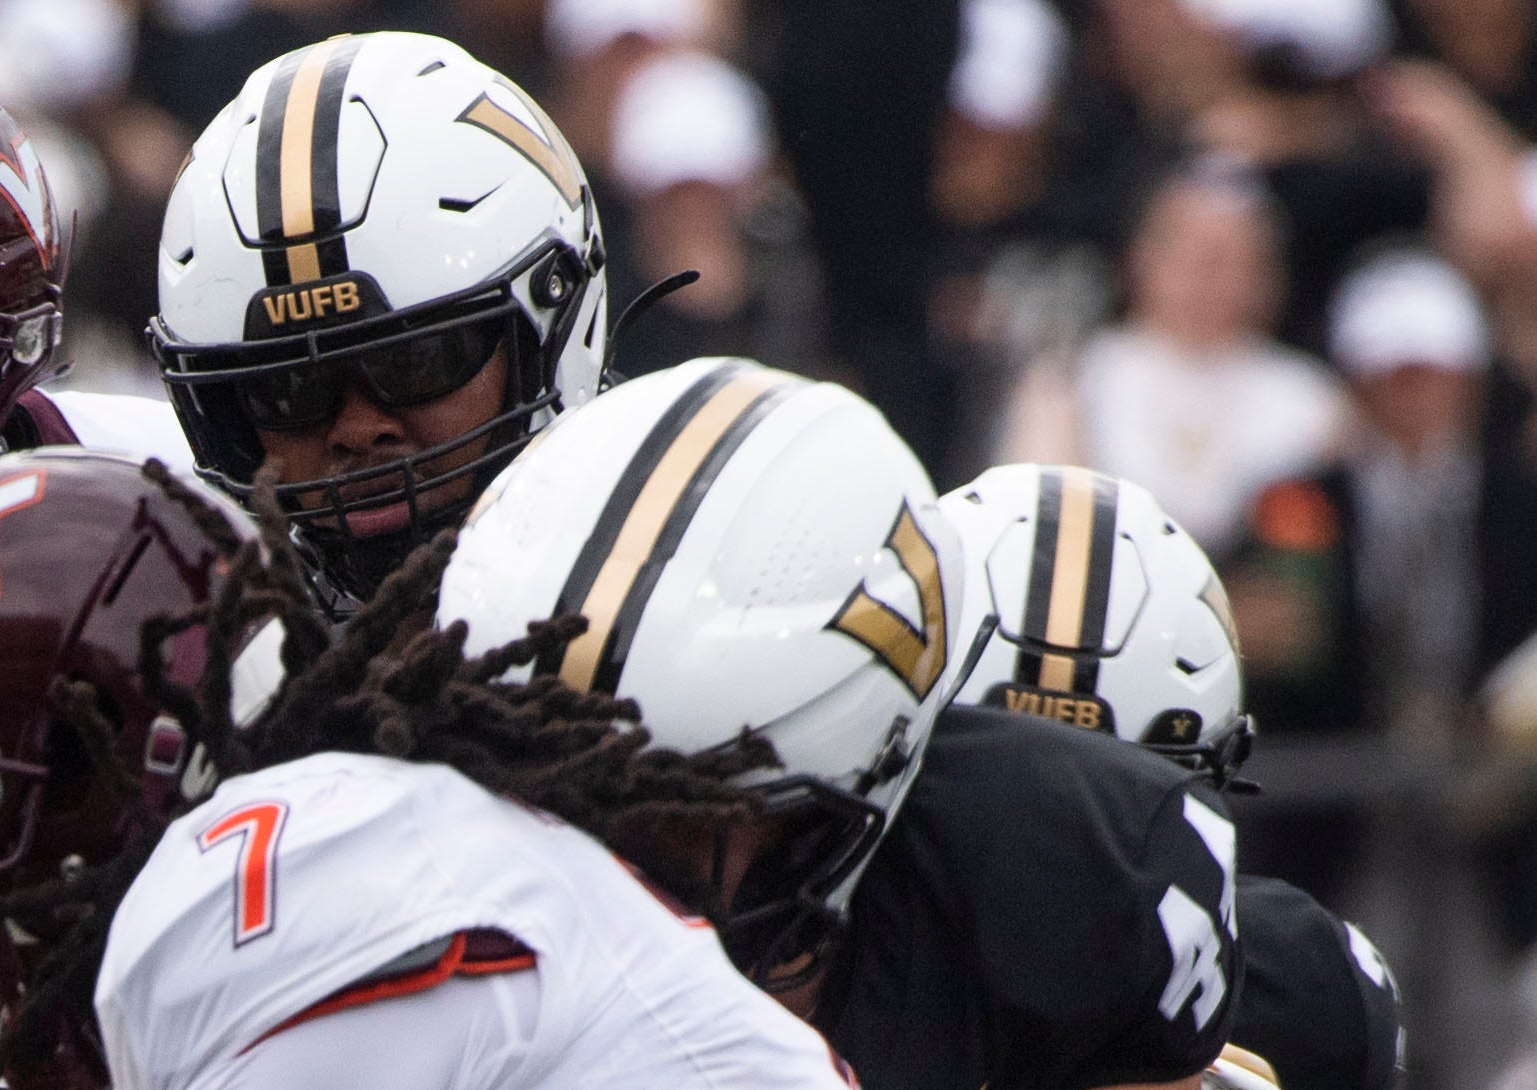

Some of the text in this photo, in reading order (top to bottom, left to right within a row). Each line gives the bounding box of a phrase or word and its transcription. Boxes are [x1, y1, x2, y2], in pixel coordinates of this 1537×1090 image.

[263, 281, 360, 325] VUFB
[821, 494, 948, 706] V
[196, 800, 290, 950] 7
